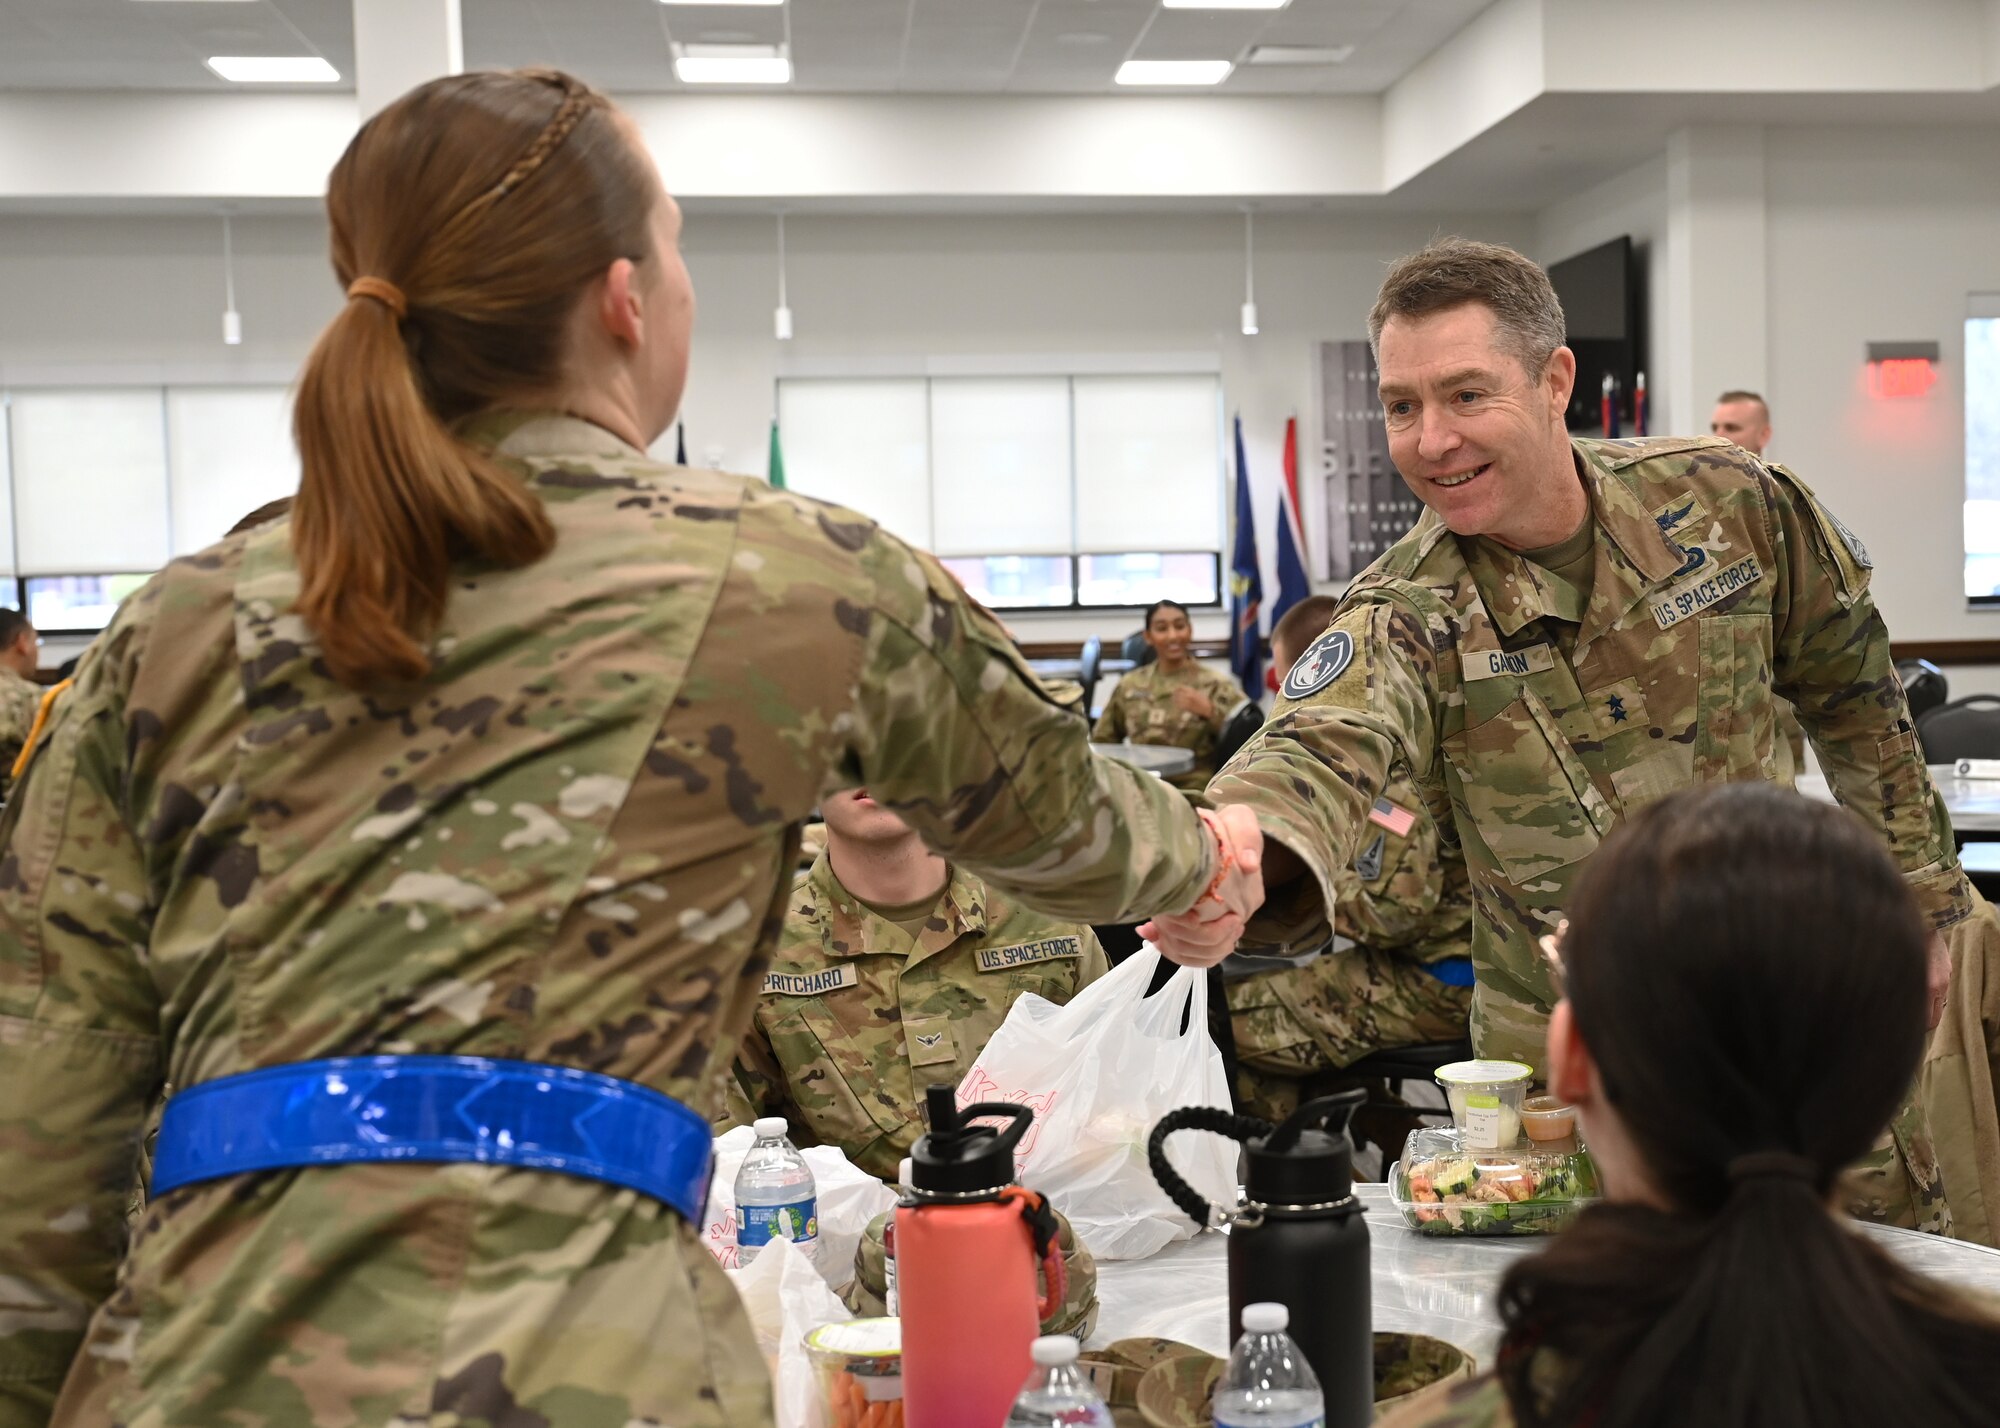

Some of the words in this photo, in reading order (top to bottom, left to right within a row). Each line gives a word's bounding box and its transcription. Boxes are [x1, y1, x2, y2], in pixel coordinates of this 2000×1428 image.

[1655, 602, 1679, 625] U.S.
[1675, 580, 1720, 615] SPACE
[1715, 558, 1759, 594] FORCE
[981, 951, 1004, 967] U.S.
[1003, 943, 1042, 965] SPACE
[1040, 938, 1079, 958] FORCE
[762, 969, 843, 993] PRITCHARD
